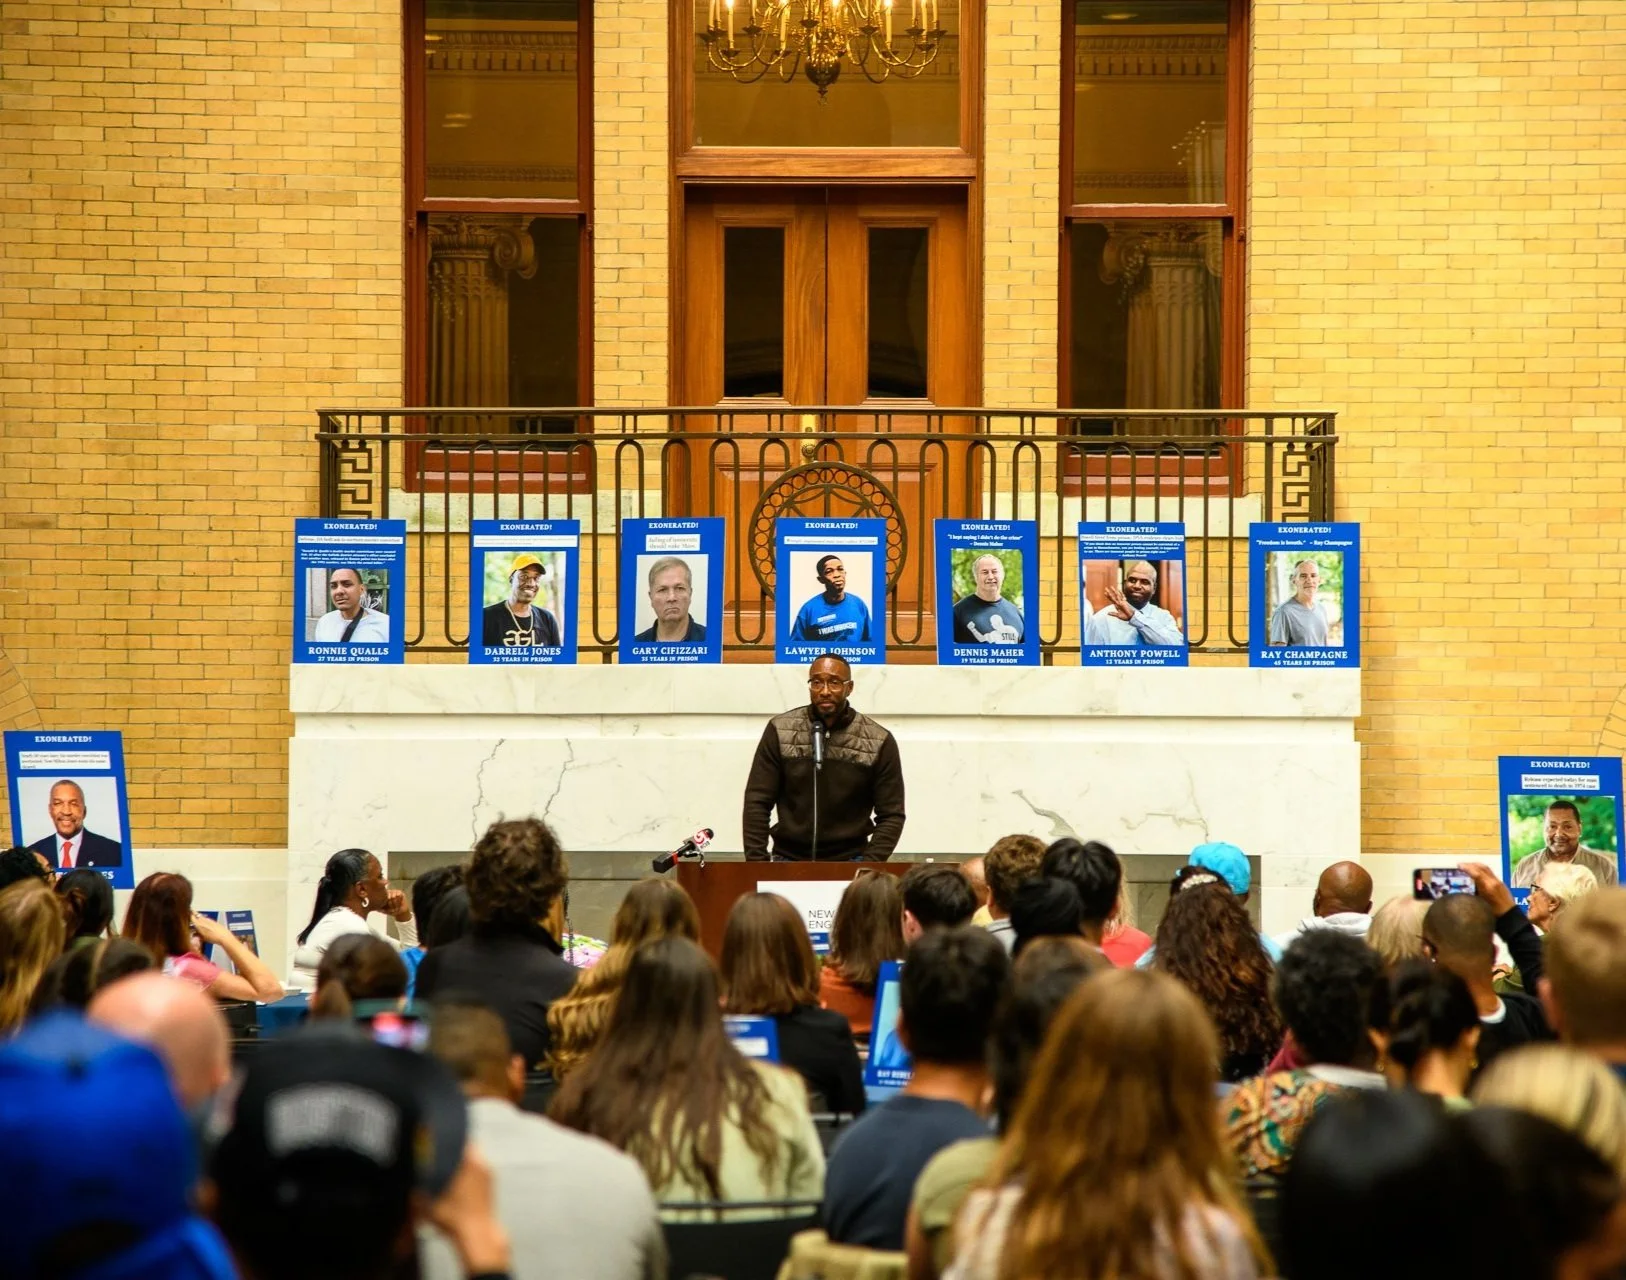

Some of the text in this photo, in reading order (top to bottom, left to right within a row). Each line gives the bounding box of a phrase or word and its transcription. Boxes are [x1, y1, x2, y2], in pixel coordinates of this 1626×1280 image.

[308, 646, 389, 656] RONNIE QUALLS
[484, 647, 561, 656] DARRELL JONES
[632, 646, 708, 655] GARY CIFIZZARI
[785, 646, 876, 655] LAWYER JOHNSON
[953, 648, 1025, 657] DENNIS MAHER
[1089, 649, 1180, 658] ANTHONY POWELL
[1261, 651, 1348, 659] RAY CHAMPAGNE
[34, 735, 92, 743] EXONERATED!
[1530, 760, 1590, 769] EXONERATED!
[808, 909, 835, 918] NEW
